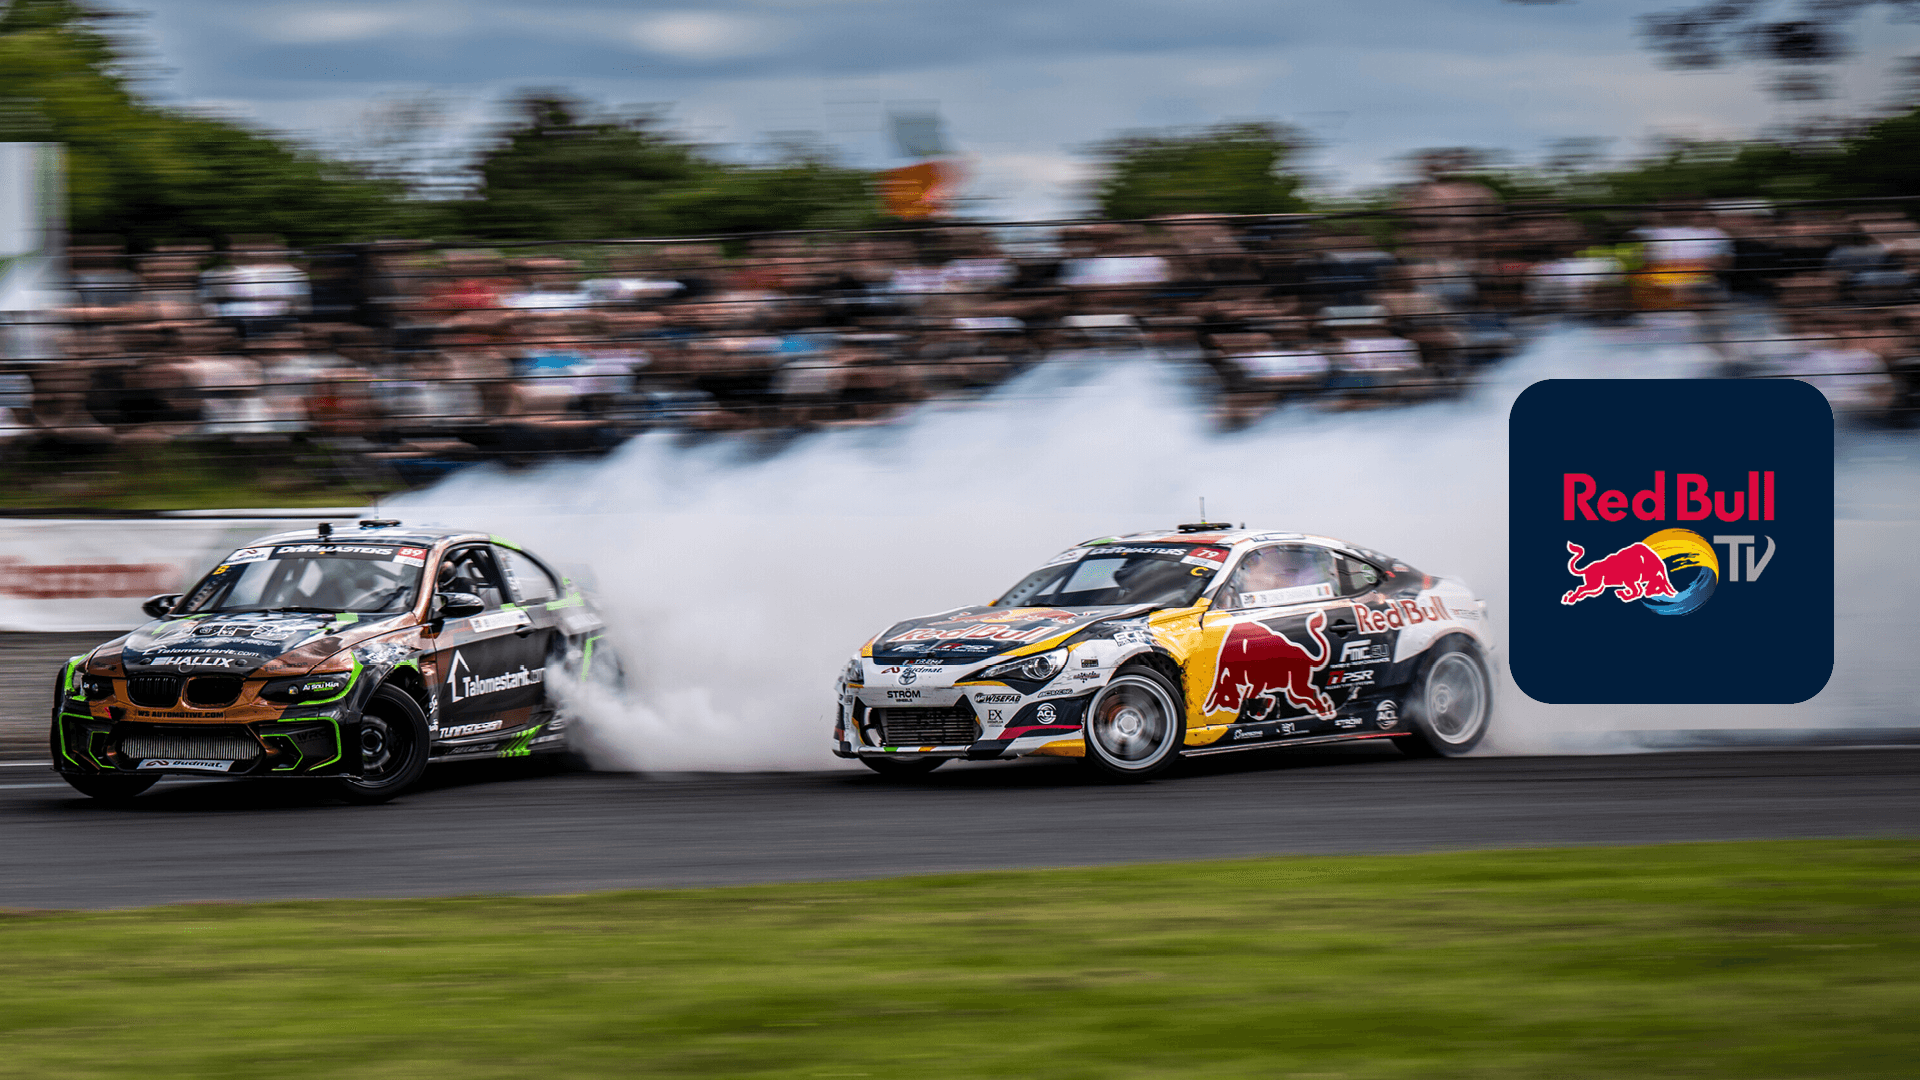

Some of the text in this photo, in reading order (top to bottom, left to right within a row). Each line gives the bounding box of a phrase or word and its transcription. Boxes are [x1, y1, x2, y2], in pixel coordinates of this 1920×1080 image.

[400, 548, 422, 557] 89
[1197, 549, 1220, 560] 79
[1189, 566, 1210, 577] C
[1354, 594, 1453, 635] Red Bull
[885, 623, 1063, 643] Red Bull
[157, 648, 260, 658] Talomestarit.com
[886, 688, 921, 698] STRÖM
[151, 710, 224, 718] AUTOMOTIVE.COM
[173, 760, 223, 768] Budmat.
